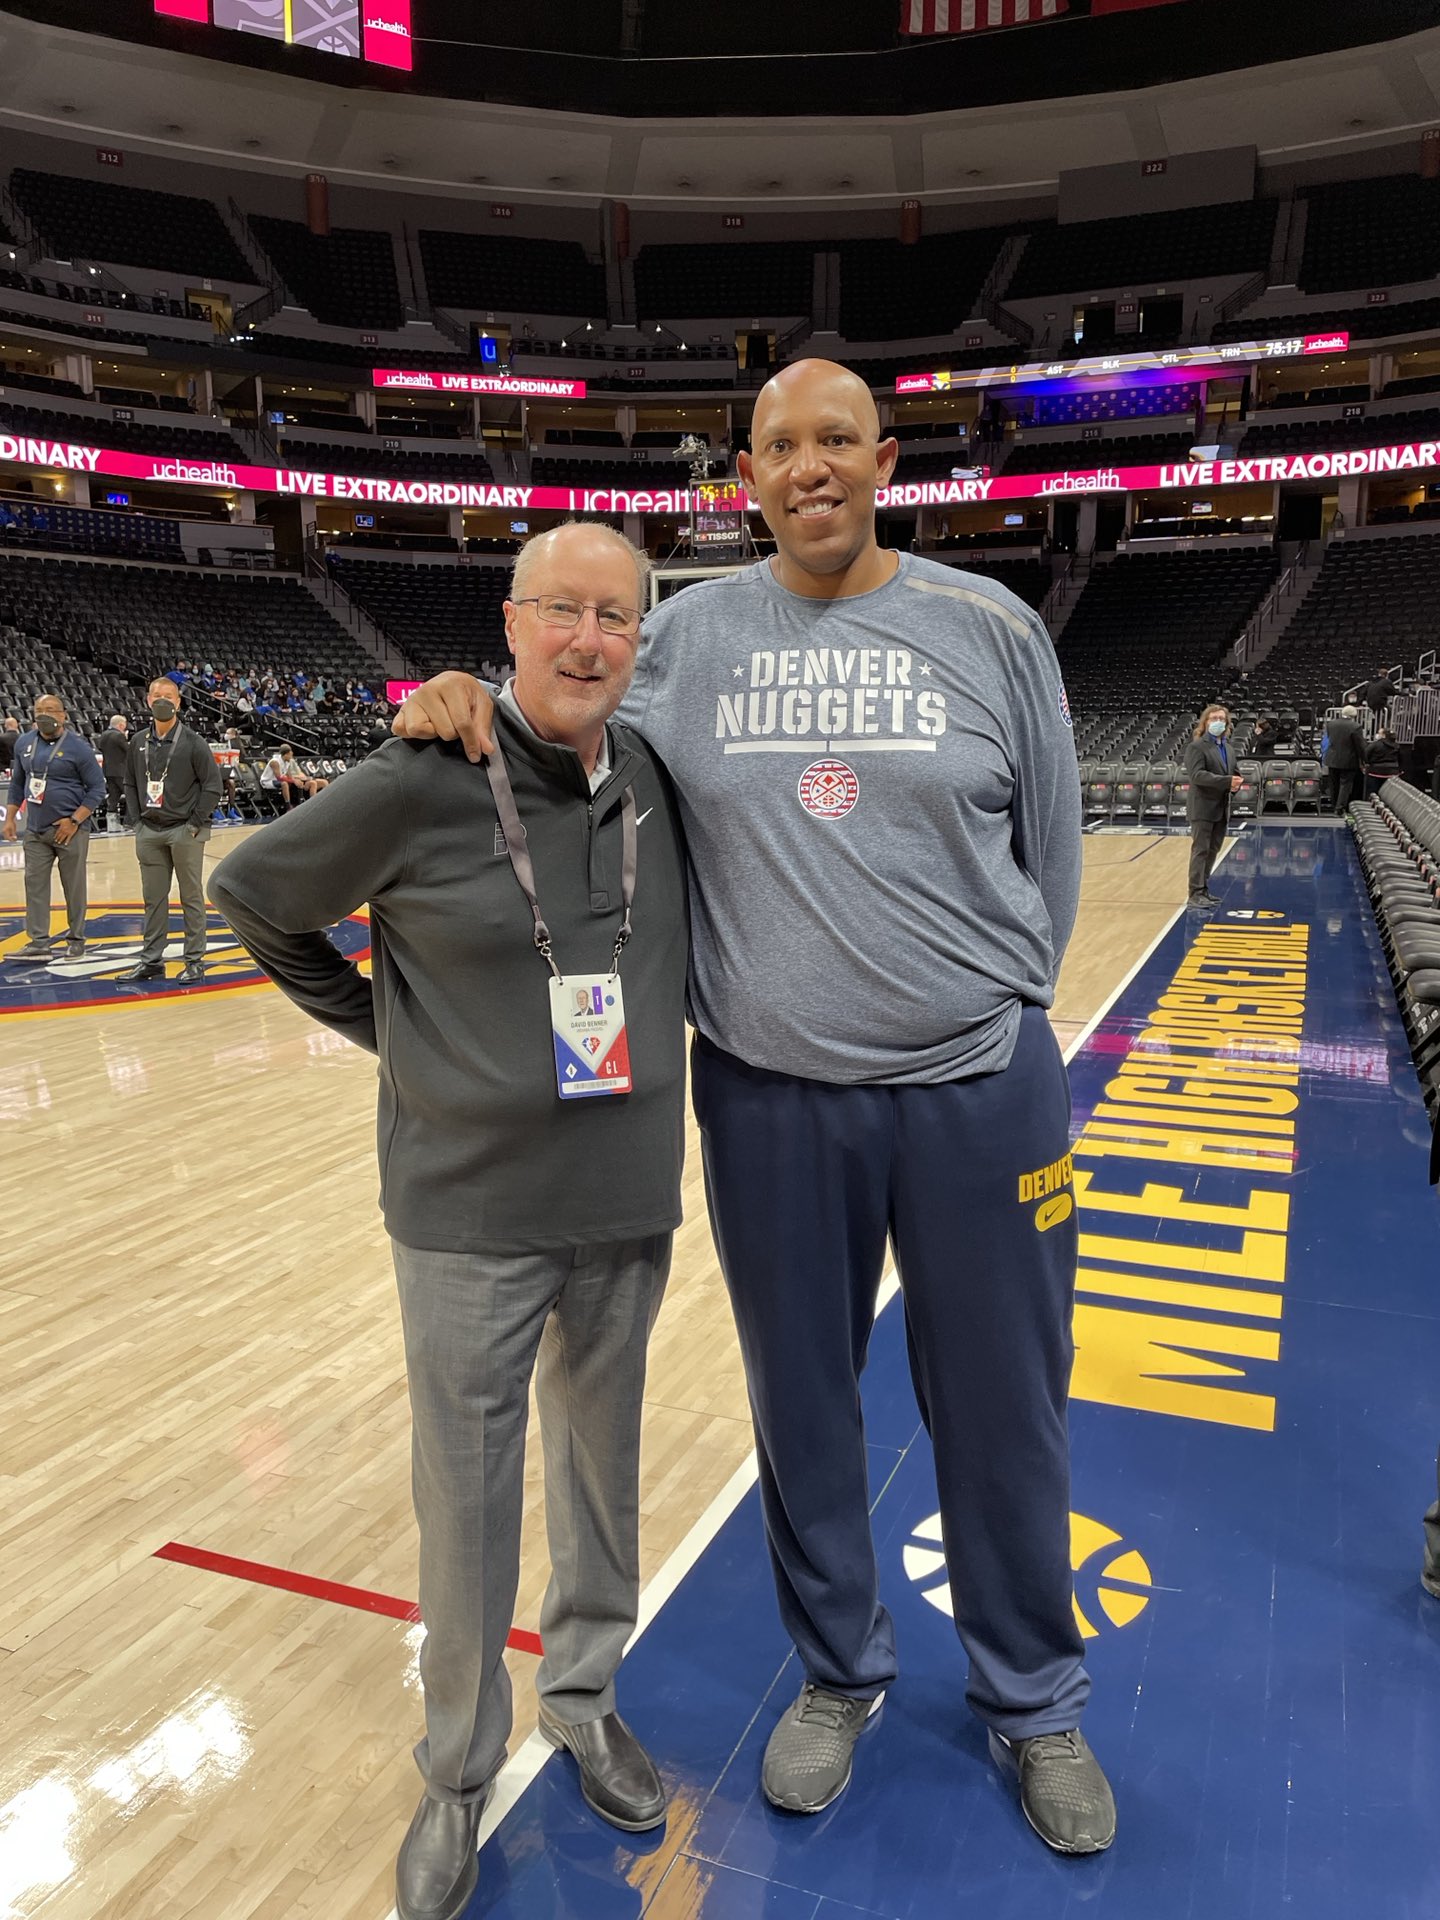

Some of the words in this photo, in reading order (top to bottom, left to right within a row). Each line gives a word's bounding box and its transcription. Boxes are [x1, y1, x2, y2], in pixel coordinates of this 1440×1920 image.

[367, 18, 408, 36] uchealth
[101, 152, 119, 163] 312
[1146, 161, 1162, 173] 322
[495, 207, 511, 216] 316
[1120, 304, 1134, 312] 321
[88, 314, 102, 323] 311
[1308, 337, 1343, 349] uchealth
[1047, 366, 1063, 375] AST
[1102, 360, 1119, 369] BLK
[1162, 354, 1179, 363] STL
[1221, 348, 1240, 358] TRN
[1265, 340, 1302, 355] 75:17
[630, 369, 642, 377] 317
[387, 372, 434, 386] uchealth
[442, 376, 469, 389] LIVE
[471, 377, 575, 395] EXTRAORDINARY
[899, 379, 930, 389] uchealth
[116, 410, 131, 420] 208
[1346, 407, 1361, 416] 218
[385, 440, 399, 448] 210
[153, 458, 238, 487] uchealth
[275, 469, 327, 496] LIVE
[333, 476, 533, 508] EXTRAORDINARY
[1042, 468, 1120, 493] uchealth
[1159, 462, 1213, 487] LIVE
[707, 531, 741, 541] TISSOT
[750, 648, 912, 688] DENVER
[715, 688, 947, 738] NUGGETS
[1071, 1051, 1300, 1174] HIGH
[1068, 1170, 1290, 1432] MILE
